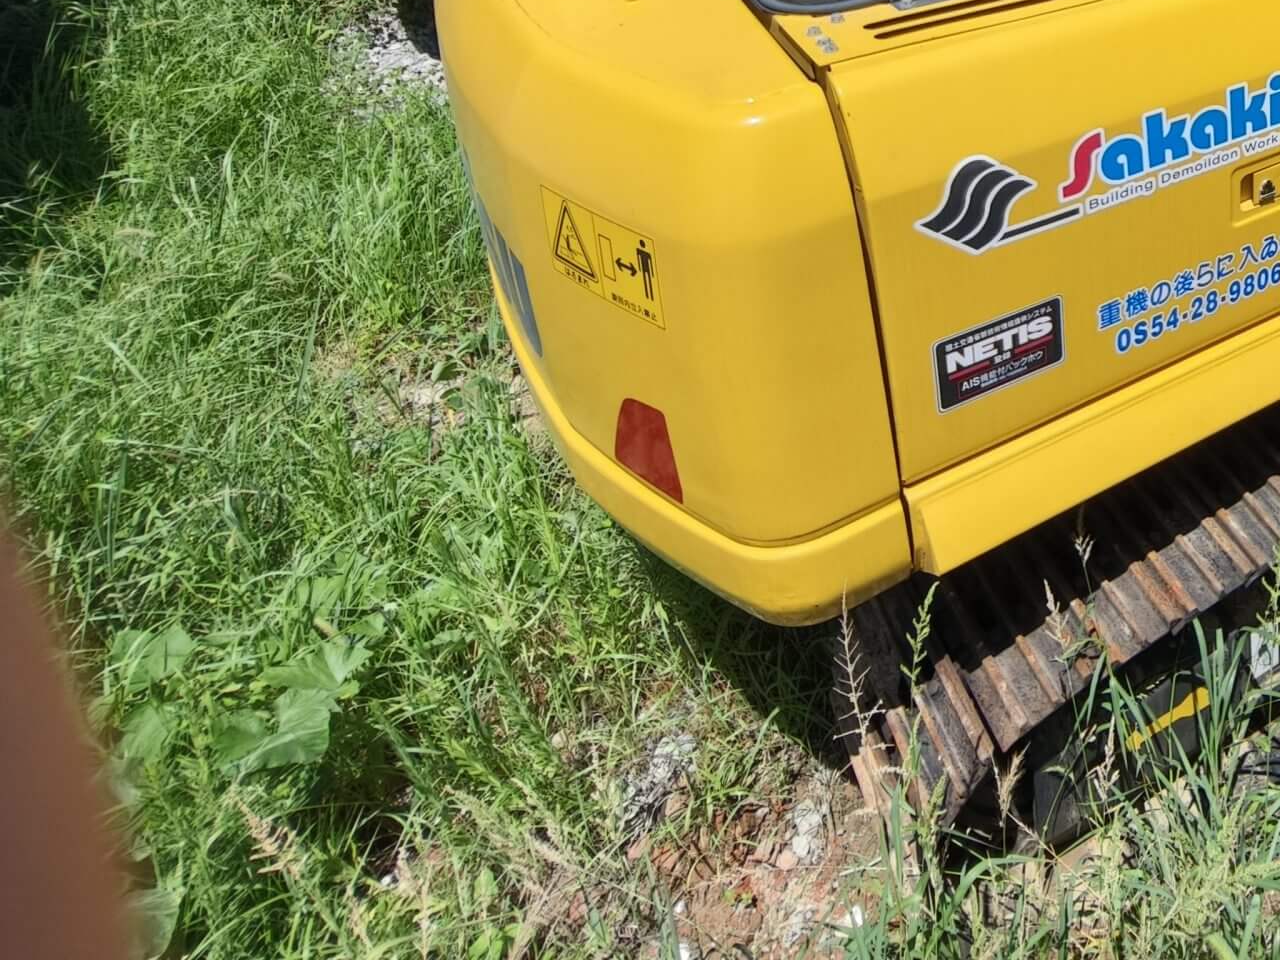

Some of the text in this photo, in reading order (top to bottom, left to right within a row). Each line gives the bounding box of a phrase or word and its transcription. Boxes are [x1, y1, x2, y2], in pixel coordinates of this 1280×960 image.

[1088, 179, 1154, 210] Building
[1243, 134, 1280, 154] Work
[945, 315, 1053, 374] NETIS
